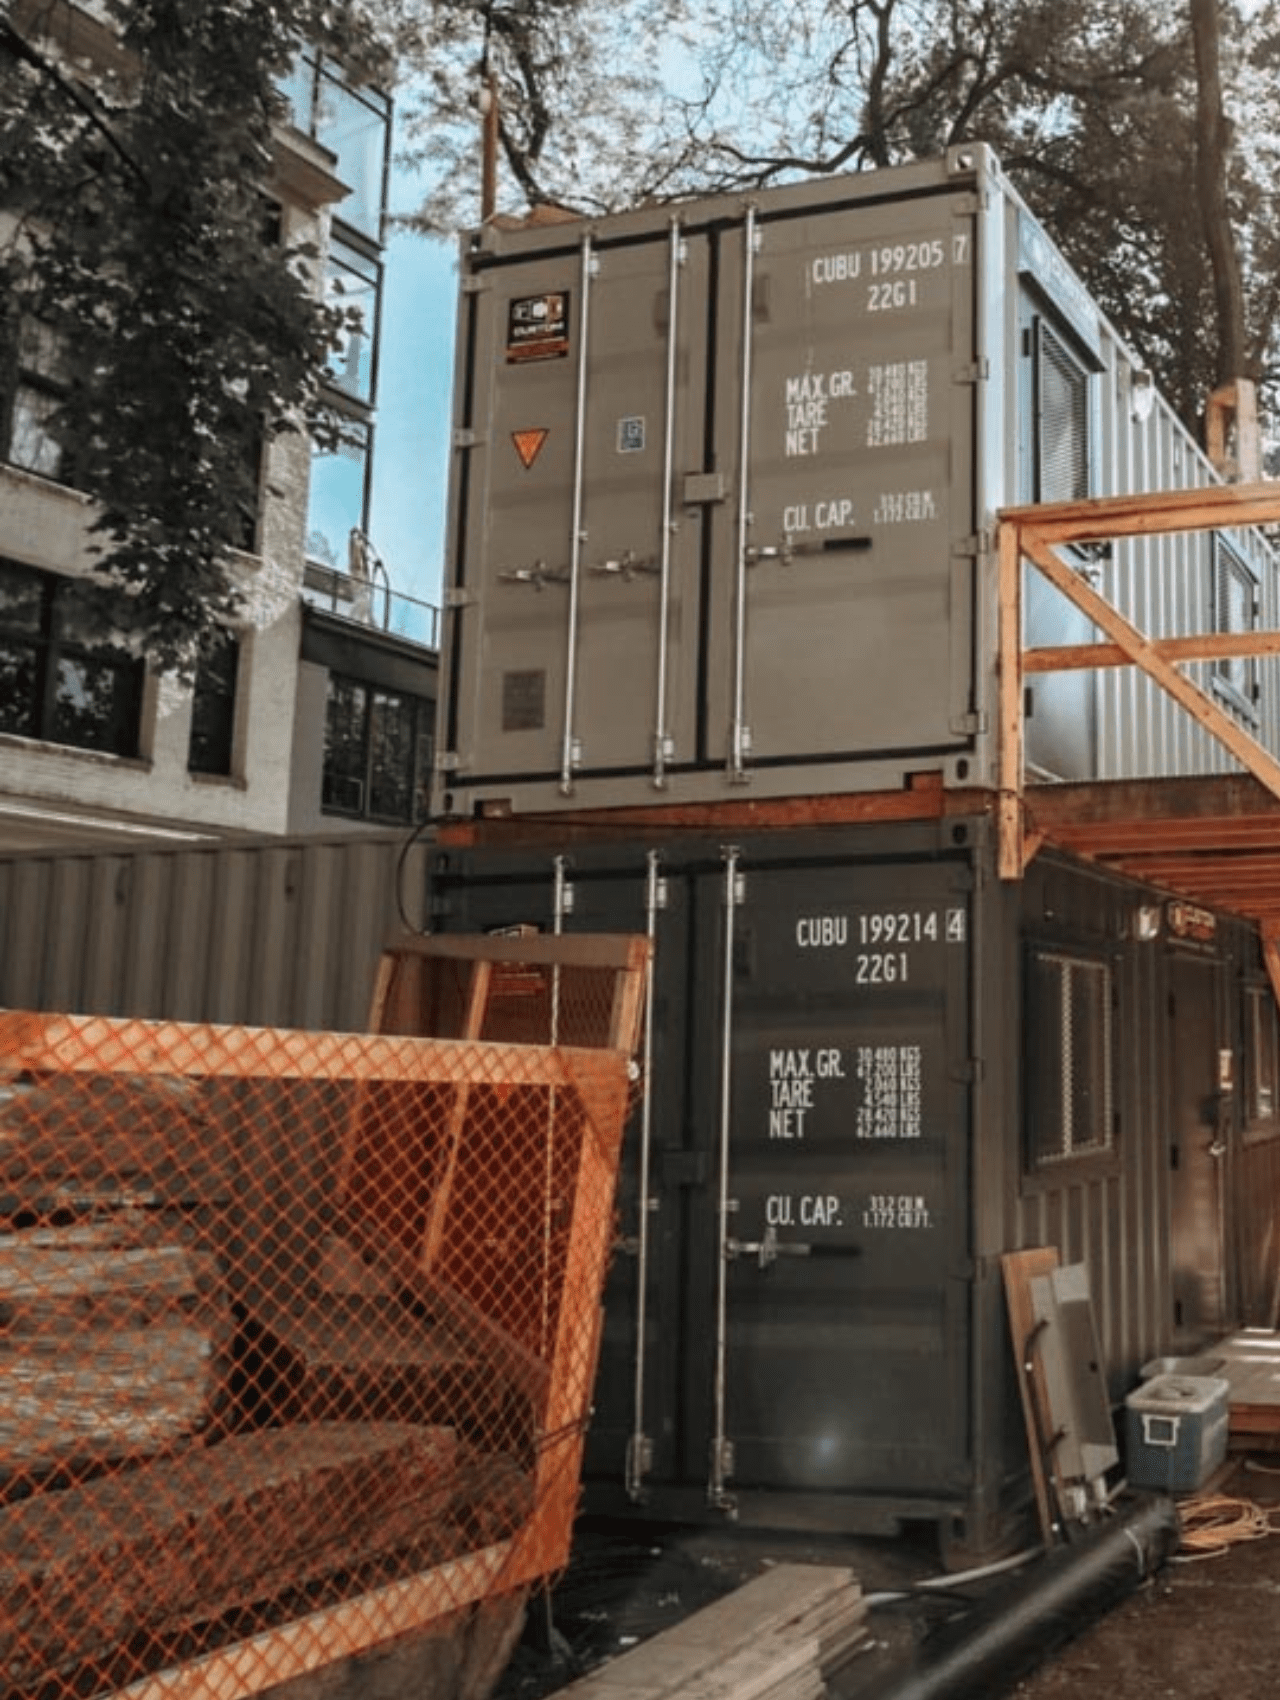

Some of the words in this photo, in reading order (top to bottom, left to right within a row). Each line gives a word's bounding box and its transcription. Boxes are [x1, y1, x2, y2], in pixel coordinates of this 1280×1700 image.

[812, 251, 861, 284] CUBU
[871, 240, 944, 276] 199205
[952, 232, 969, 265] 7
[867, 278, 916, 311] 22G1
[786, 399, 829, 430] TARE
[784, 427, 820, 457] NET
[796, 916, 848, 947] CUBU
[859, 911, 938, 944] 199214
[946, 908, 966, 943] 4
[855, 953, 908, 984] 22G1
[770, 1079, 814, 1108] TARE
[769, 1107, 807, 1138] NET
[766, 1195, 795, 1225] CU.
[800, 1195, 844, 1227] CAP.
